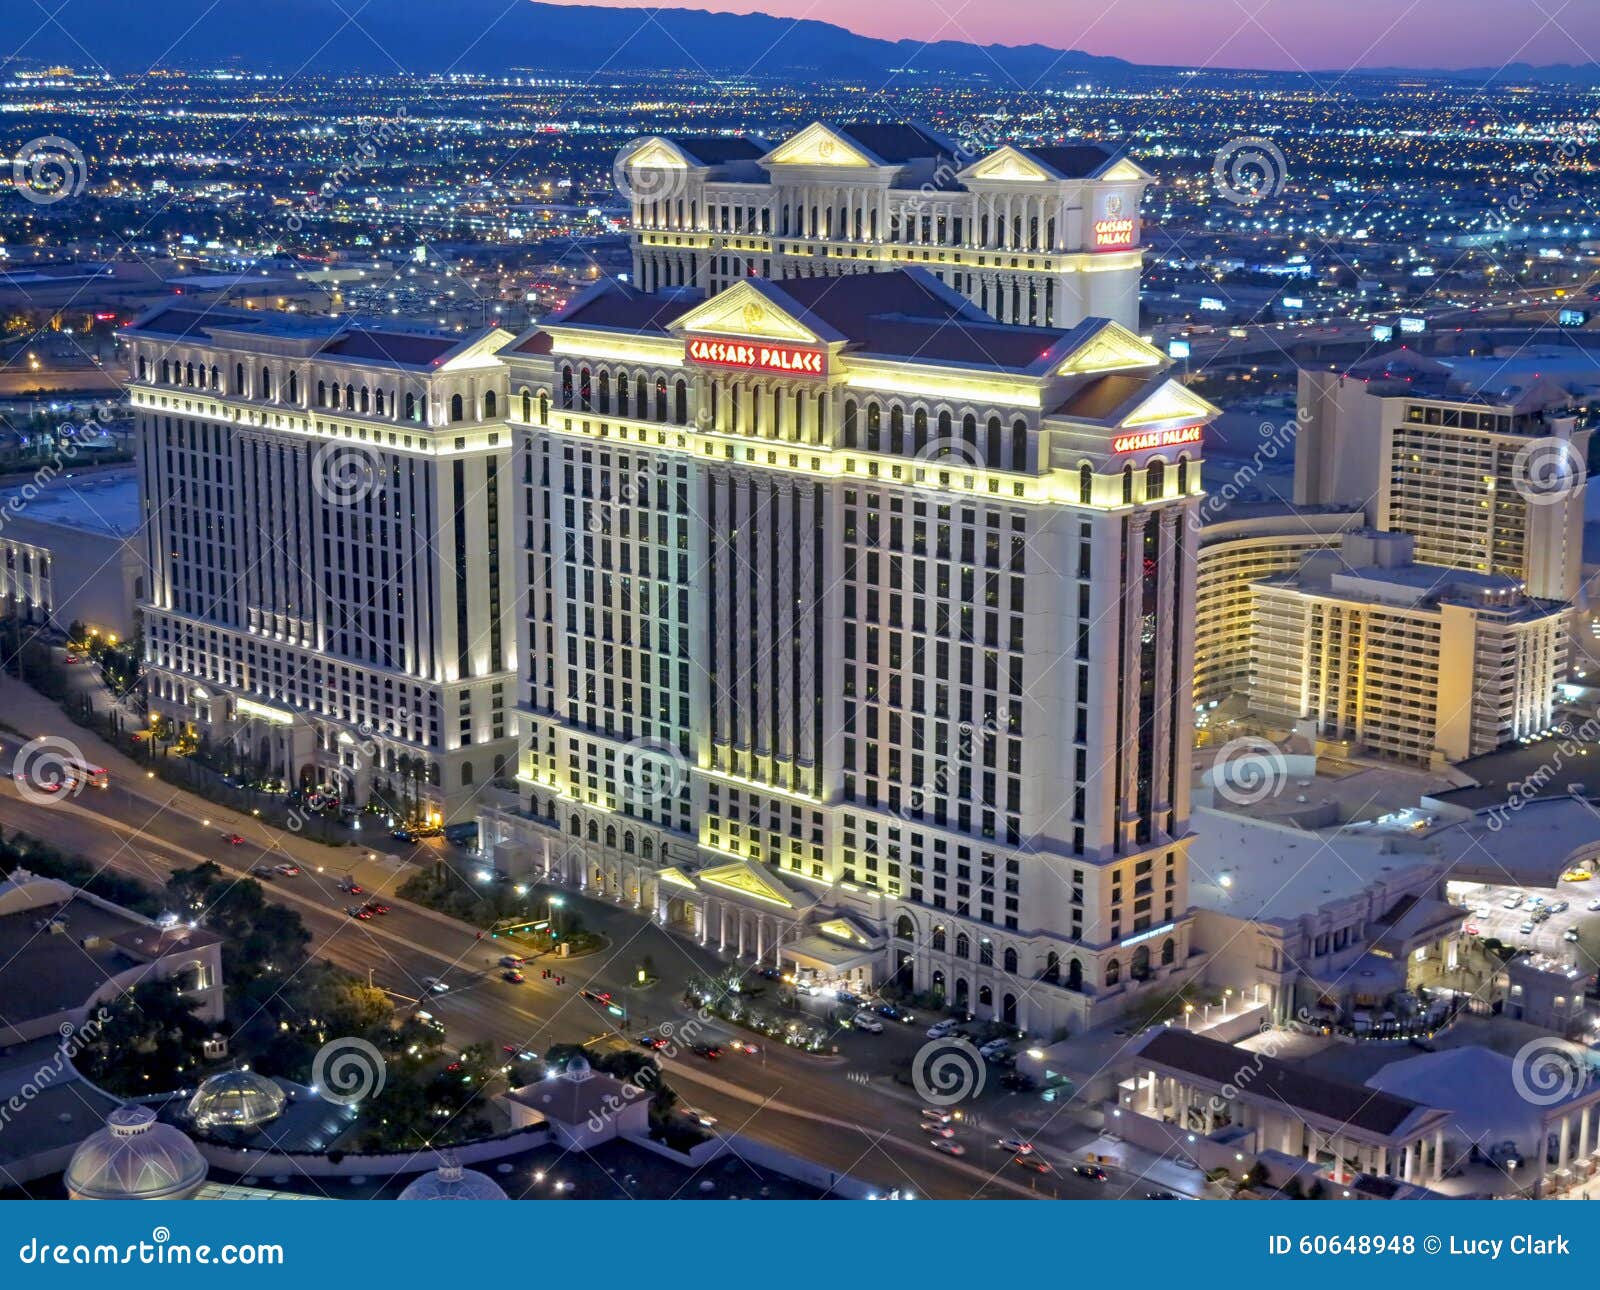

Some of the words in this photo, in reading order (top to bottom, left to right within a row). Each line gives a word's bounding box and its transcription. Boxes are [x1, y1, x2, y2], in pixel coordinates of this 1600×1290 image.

[1095, 220, 1133, 233] CAESARS
[1096, 232, 1131, 245] PALACE
[690, 341, 755, 365] CAESARS
[760, 348, 821, 372] PALACE
[1114, 433, 1160, 452] CAESARS
[1162, 427, 1200, 445] PALACE
